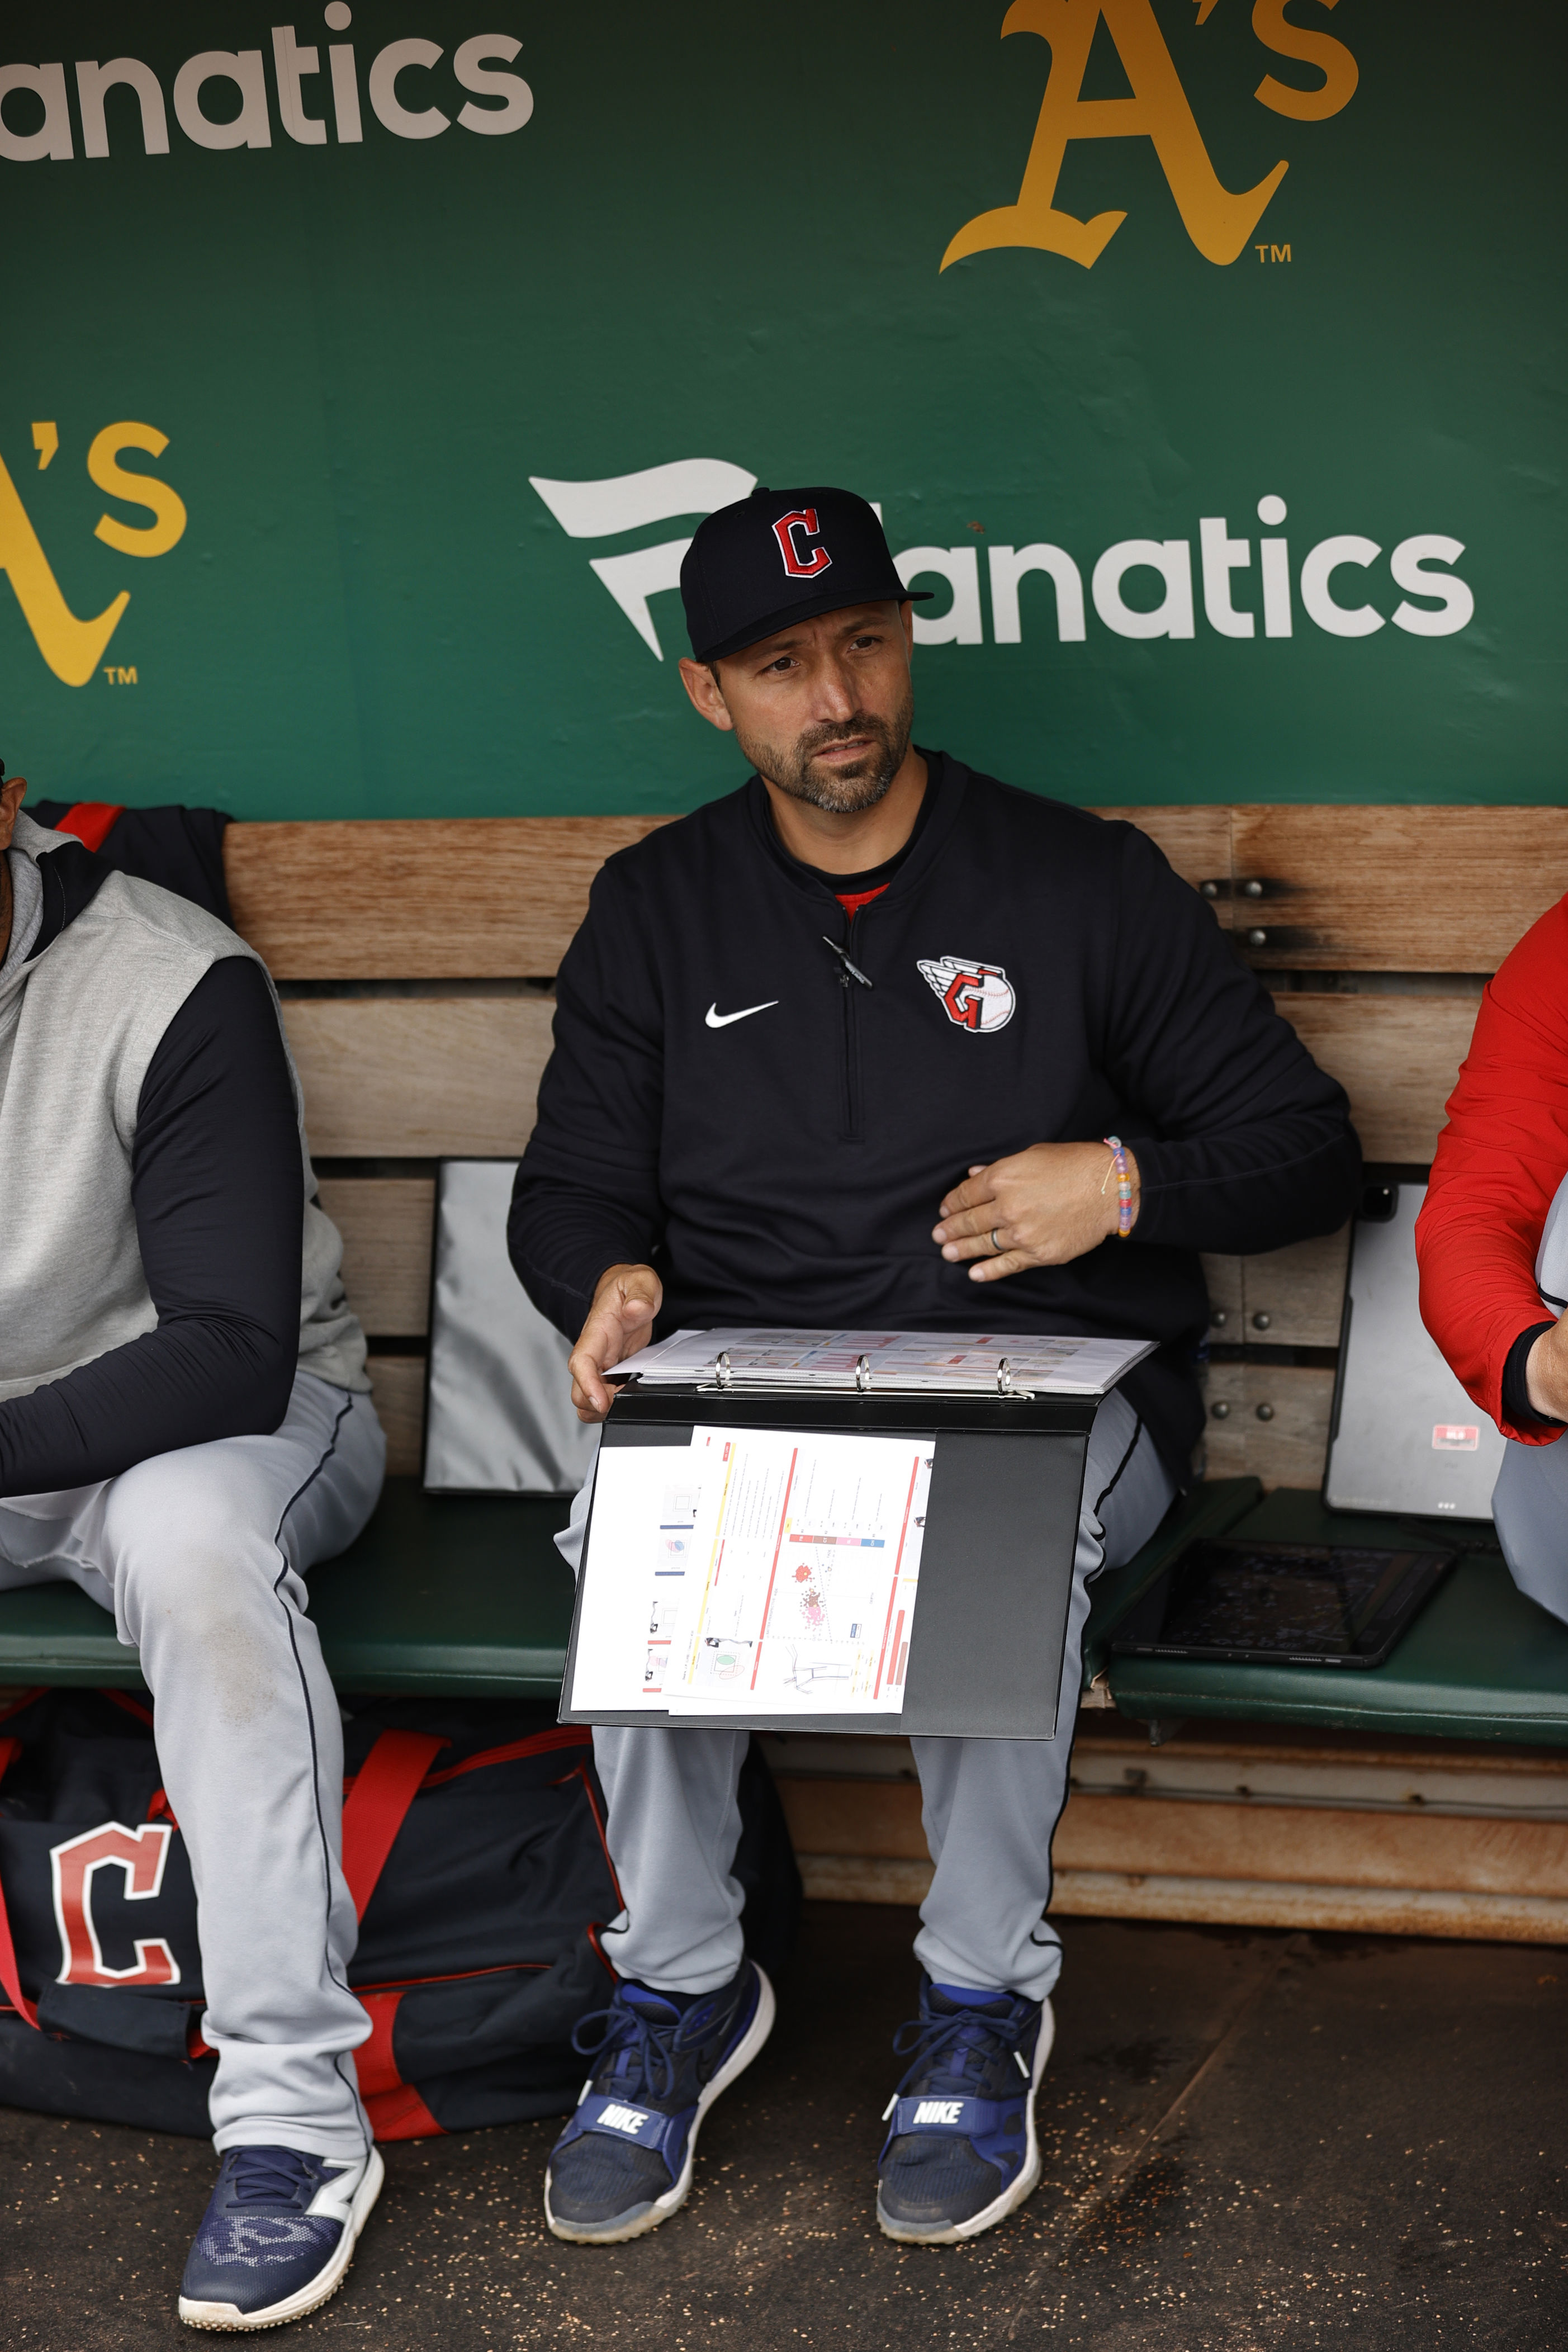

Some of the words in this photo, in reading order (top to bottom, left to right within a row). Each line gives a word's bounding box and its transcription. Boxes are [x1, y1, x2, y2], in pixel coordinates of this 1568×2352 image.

[1255, 244, 1292, 263] TM
[771, 508, 832, 578] C
[872, 495, 1475, 646] anatics
[103, 666, 138, 685] TM
[49, 1821, 181, 1988] C
[596, 2103, 650, 2135] NIKE
[913, 2101, 965, 2124] NIKE
